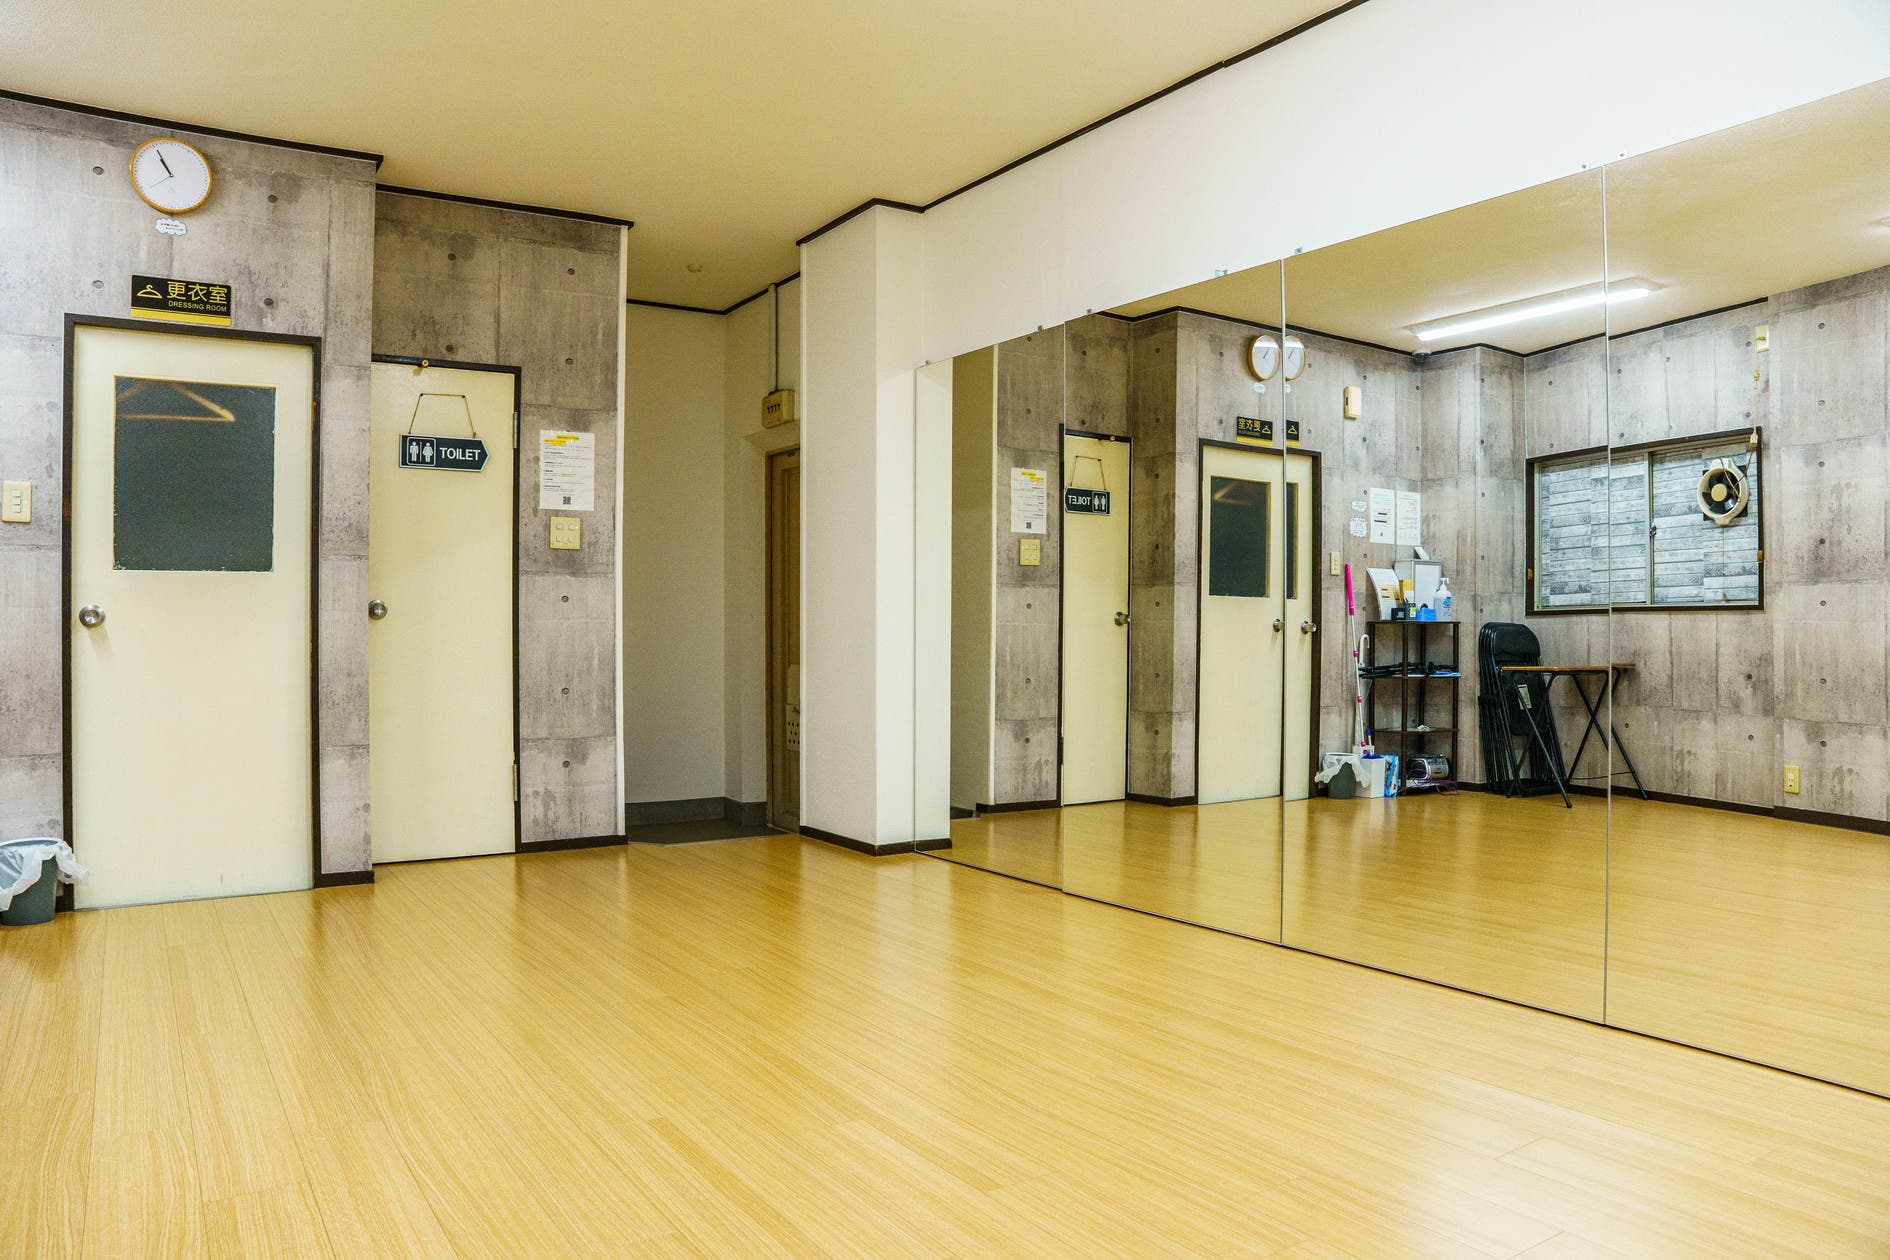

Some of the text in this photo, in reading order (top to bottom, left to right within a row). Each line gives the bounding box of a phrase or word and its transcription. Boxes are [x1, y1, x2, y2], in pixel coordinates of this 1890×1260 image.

[167, 281, 228, 304] 更衣室
[168, 300, 227, 312] DRESSING ROOM
[440, 447, 481, 461] TOILET
